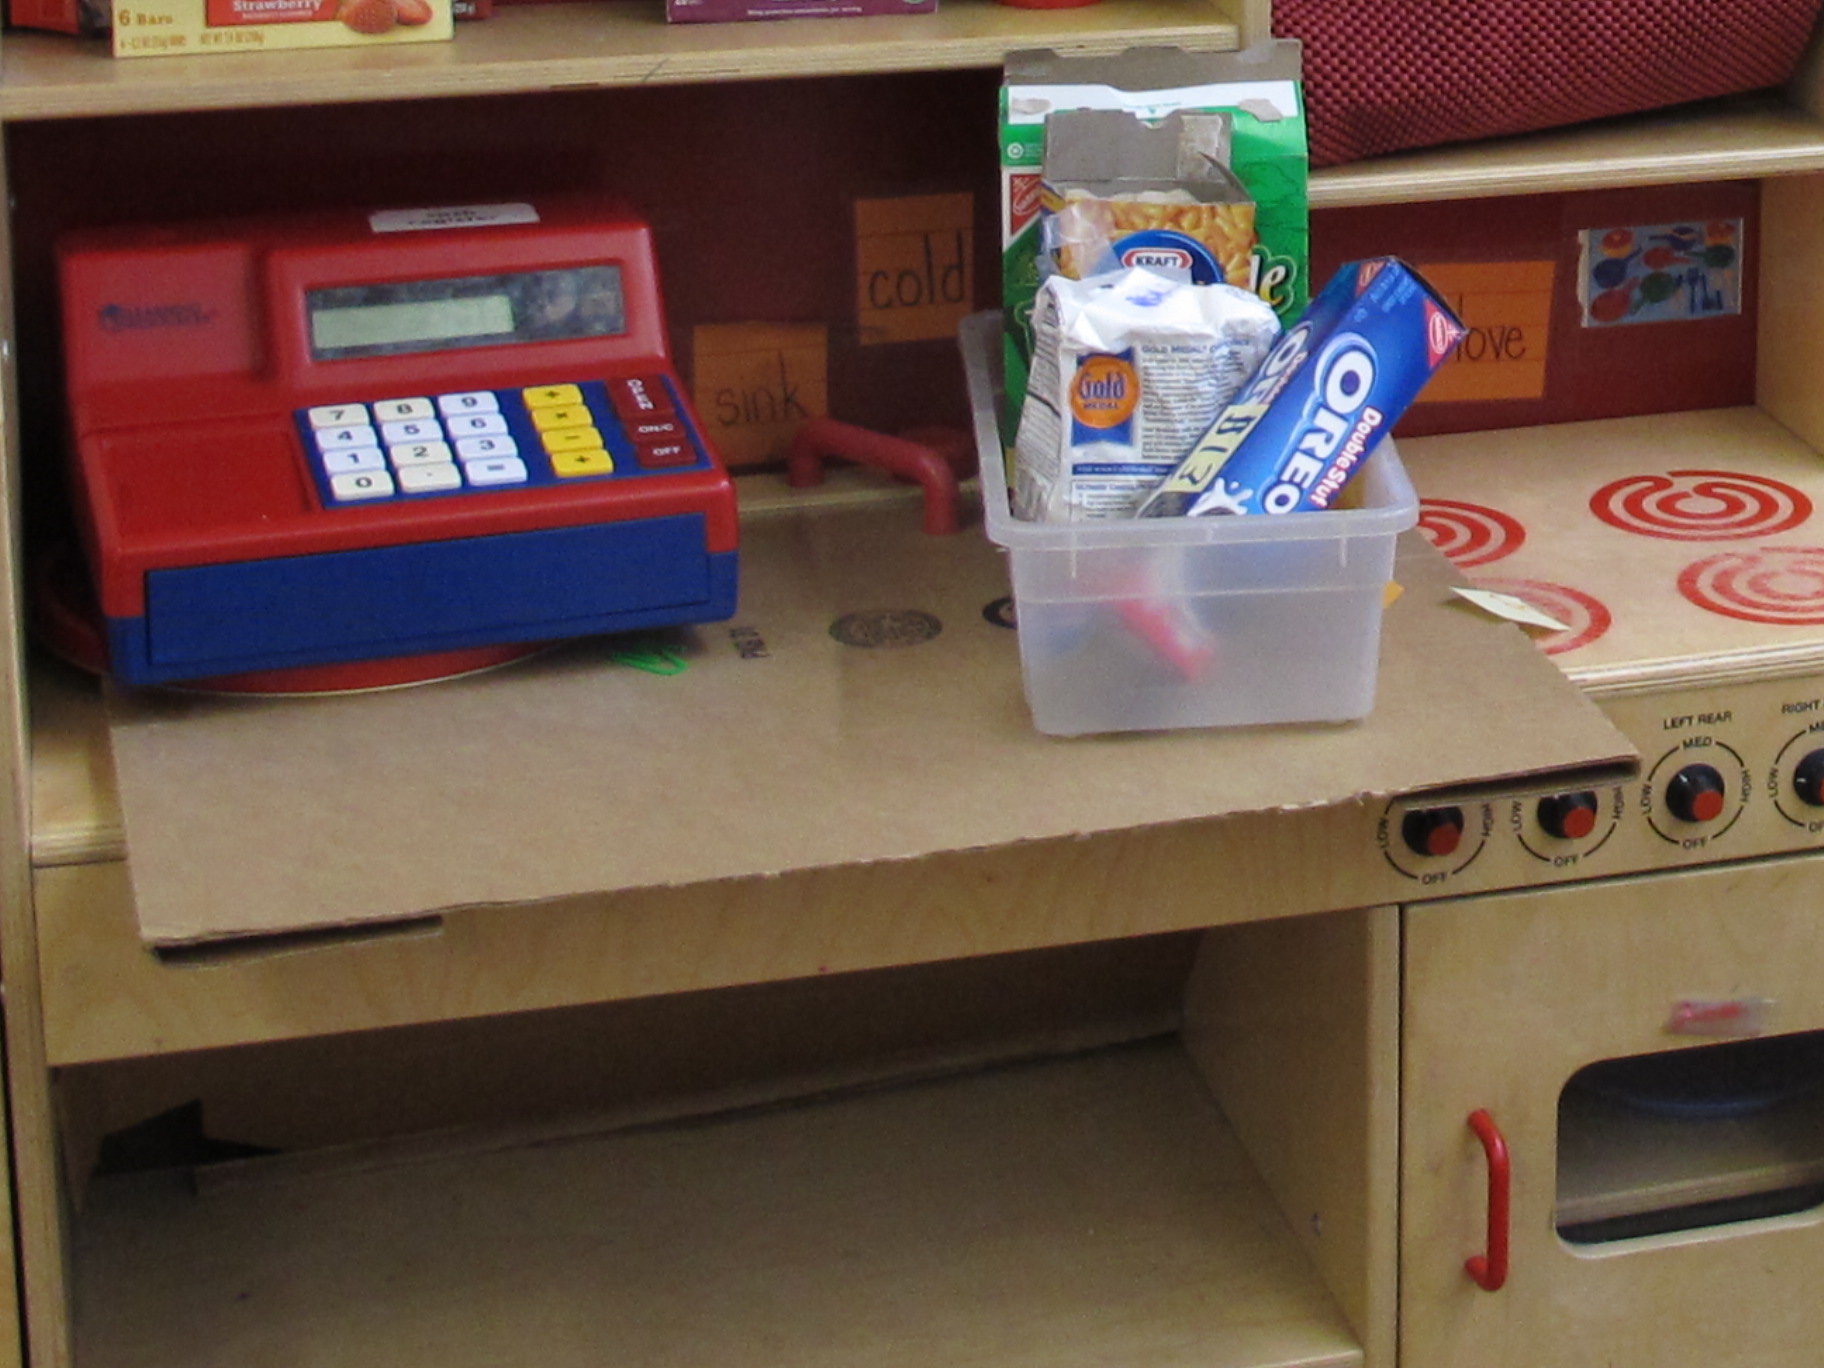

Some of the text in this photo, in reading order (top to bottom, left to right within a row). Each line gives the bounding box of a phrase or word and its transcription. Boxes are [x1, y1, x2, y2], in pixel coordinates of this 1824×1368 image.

[119, 10, 131, 26] 6
[868, 232, 966, 310] cold
[1136, 256, 1179, 268] KRAFT
[715, 350, 808, 427] sink
[1079, 370, 1126, 400] Gold
[329, 397, 477, 421] 7 8 9
[337, 419, 486, 442] 4 5 6
[1263, 349, 1376, 515] OREO
[347, 440, 496, 464] 1 2 3
[652, 446, 681, 457] OFF
[1307, 406, 1384, 508] Double Stuf
[354, 477, 373, 489] 0
[1781, 698, 1820, 714] RIGHT
[1663, 711, 1732, 730] LEFT REAR
[1682, 735, 1713, 749] MED
[1741, 769, 1751, 803] HIGH
[1768, 767, 1779, 799] LOW
[1613, 787, 1625, 820] HIGH
[1642, 783, 1652, 816] LOW
[1482, 803, 1495, 837] HIGH
[1510, 800, 1523, 830] LOW
[1377, 818, 1389, 848] LOW
[1682, 838, 1707, 850] OFF
[1553, 854, 1579, 867] OFF
[1422, 871, 1448, 884] OFF
